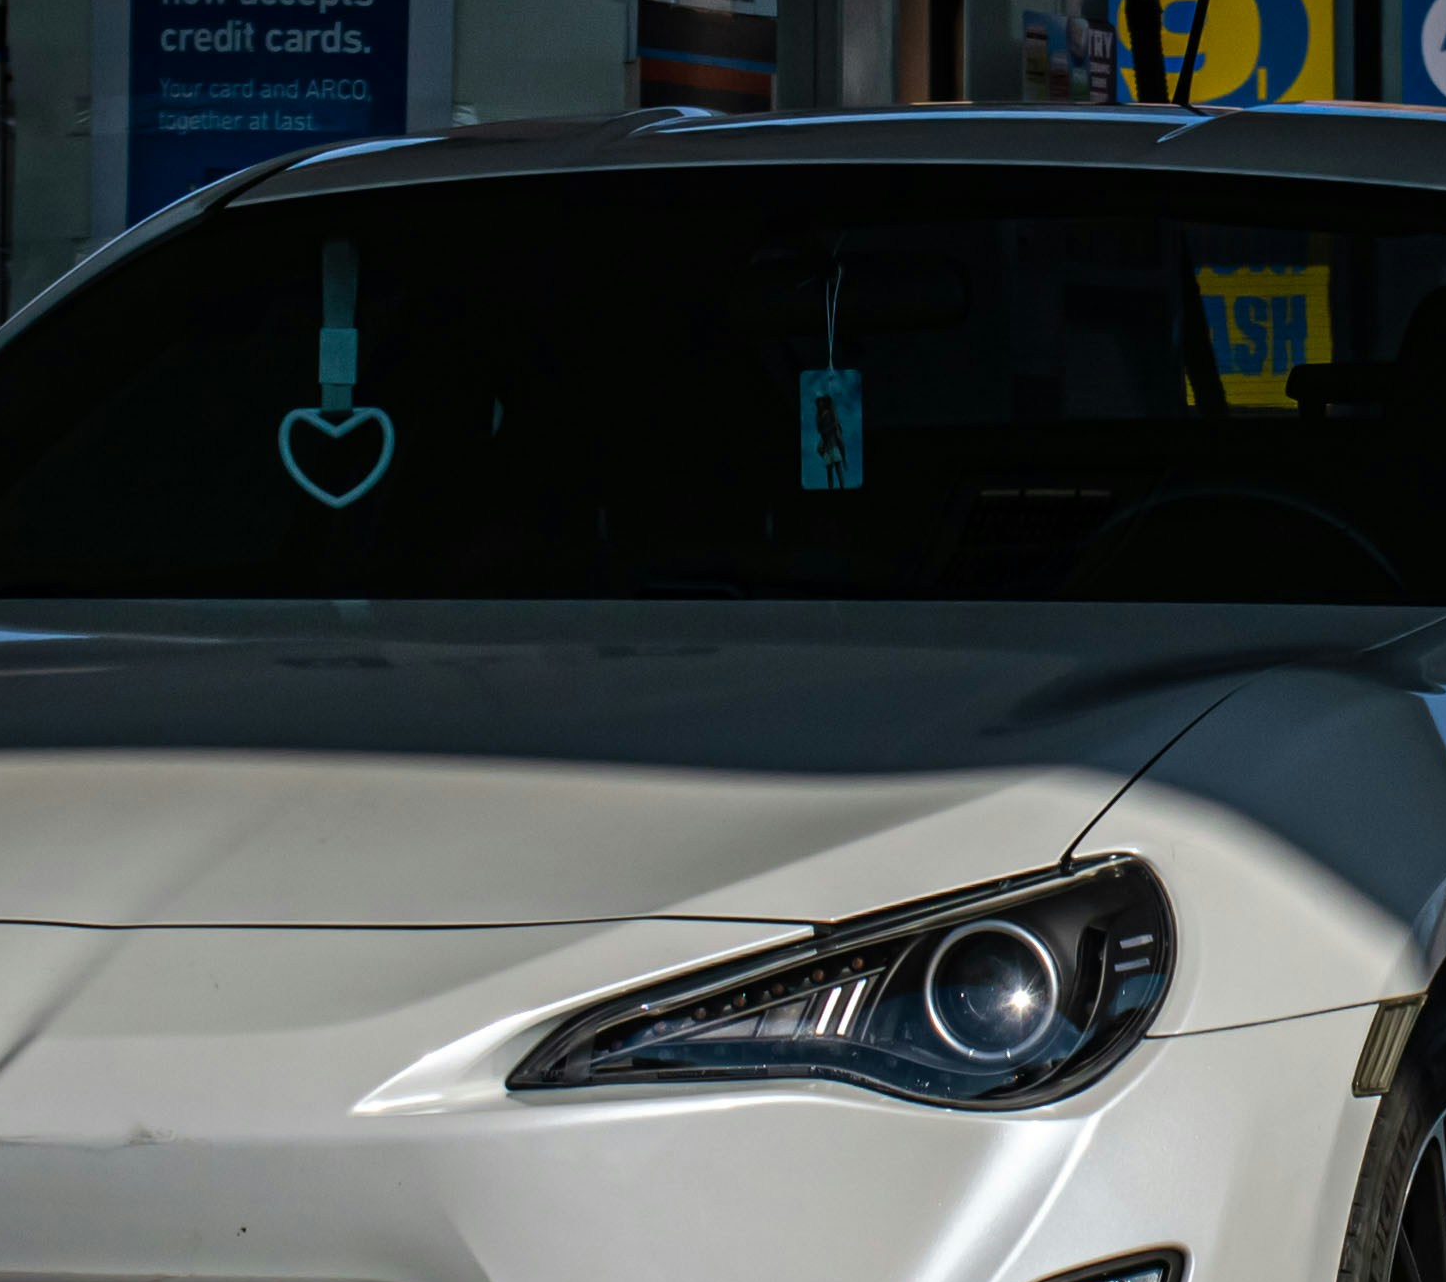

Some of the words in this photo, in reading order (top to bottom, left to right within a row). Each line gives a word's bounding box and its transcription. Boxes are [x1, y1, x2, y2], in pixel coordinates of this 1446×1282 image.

[160, 19, 255, 48] credit
[265, 20, 372, 54] cards.
[159, 77, 203, 99] Your
[209, 77, 254, 99] card
[259, 78, 300, 100] and
[159, 110, 243, 136] together
[248, 112, 269, 132] at
